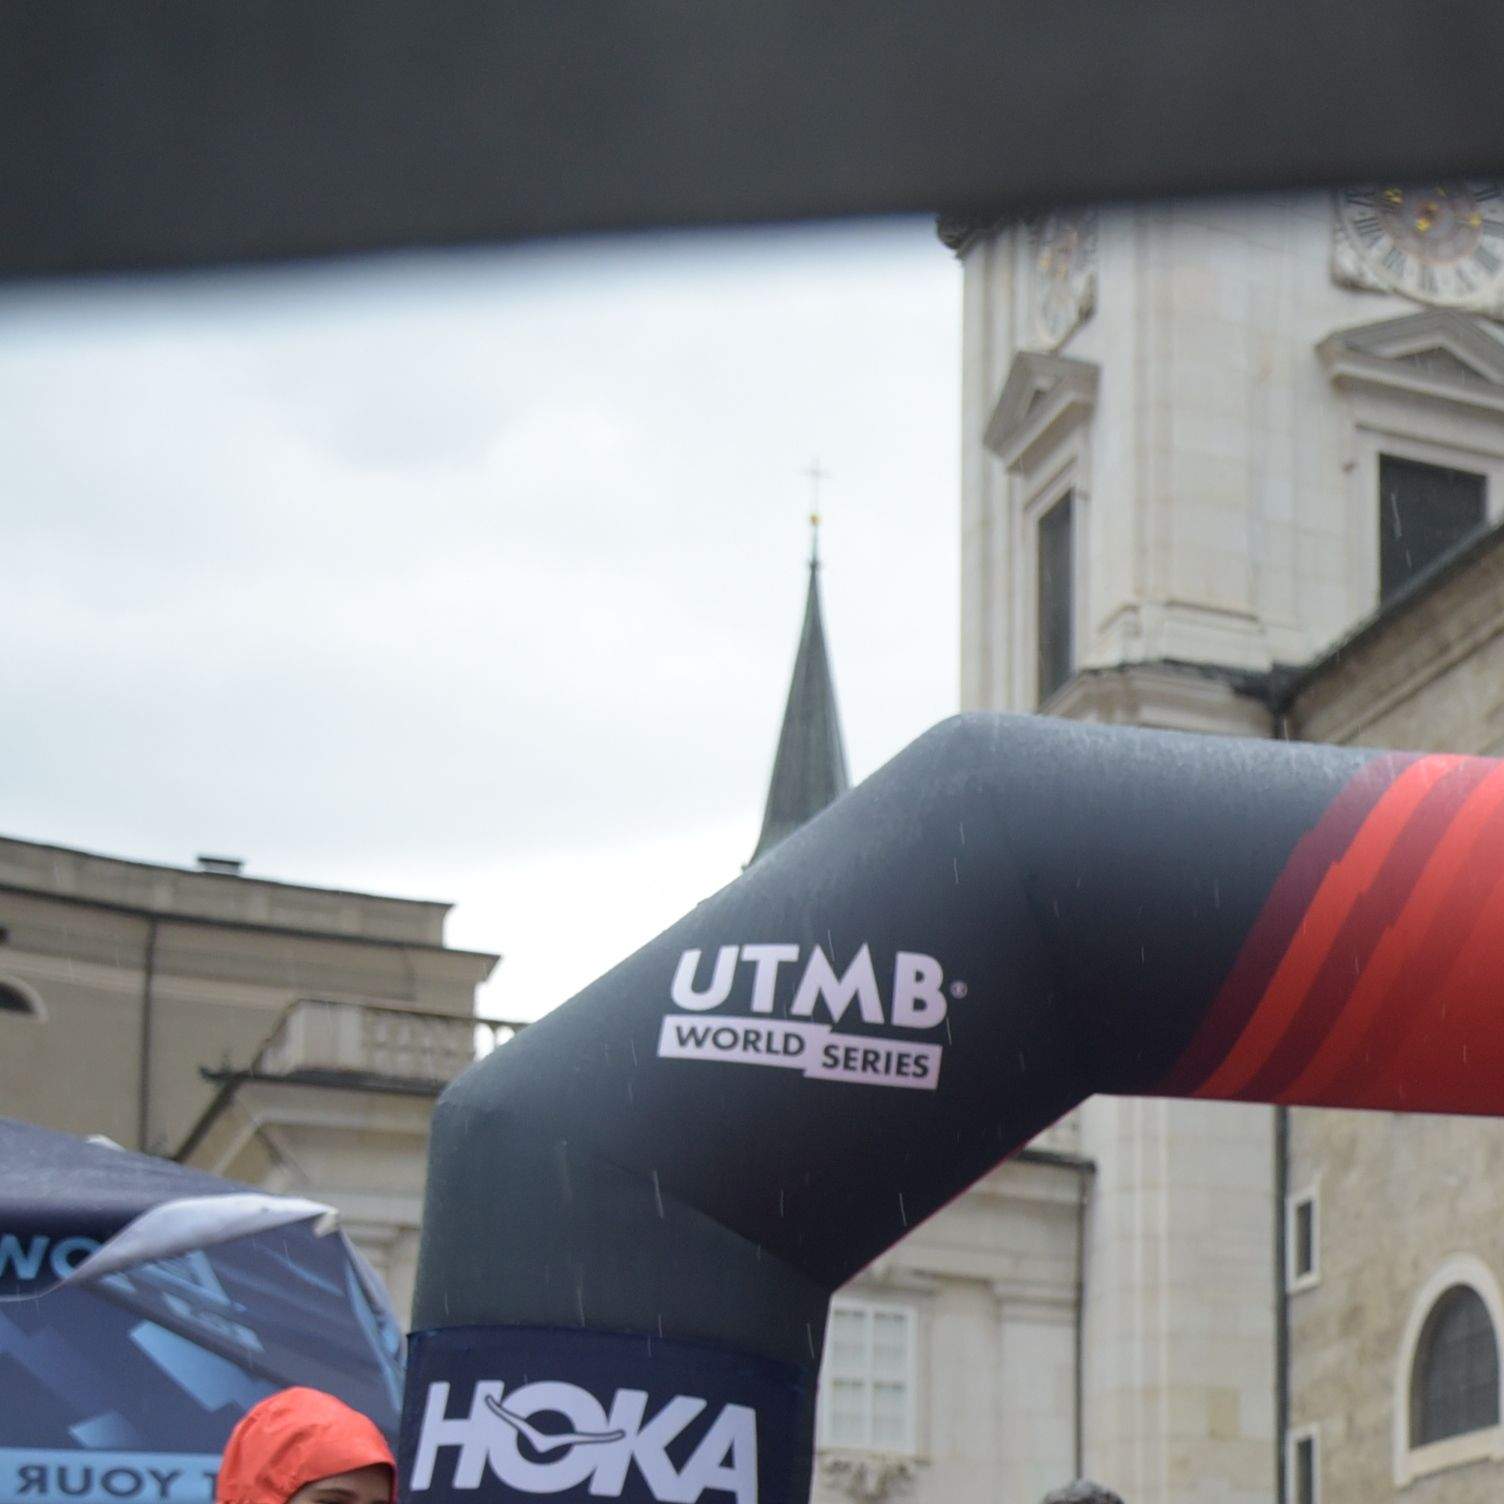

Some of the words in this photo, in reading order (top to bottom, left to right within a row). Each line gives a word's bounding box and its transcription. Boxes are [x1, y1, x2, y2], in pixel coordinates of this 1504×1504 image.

[671, 943, 948, 1029] UTMB
[676, 1026, 805, 1057] WORLD
[822, 1044, 929, 1079] SERIES
